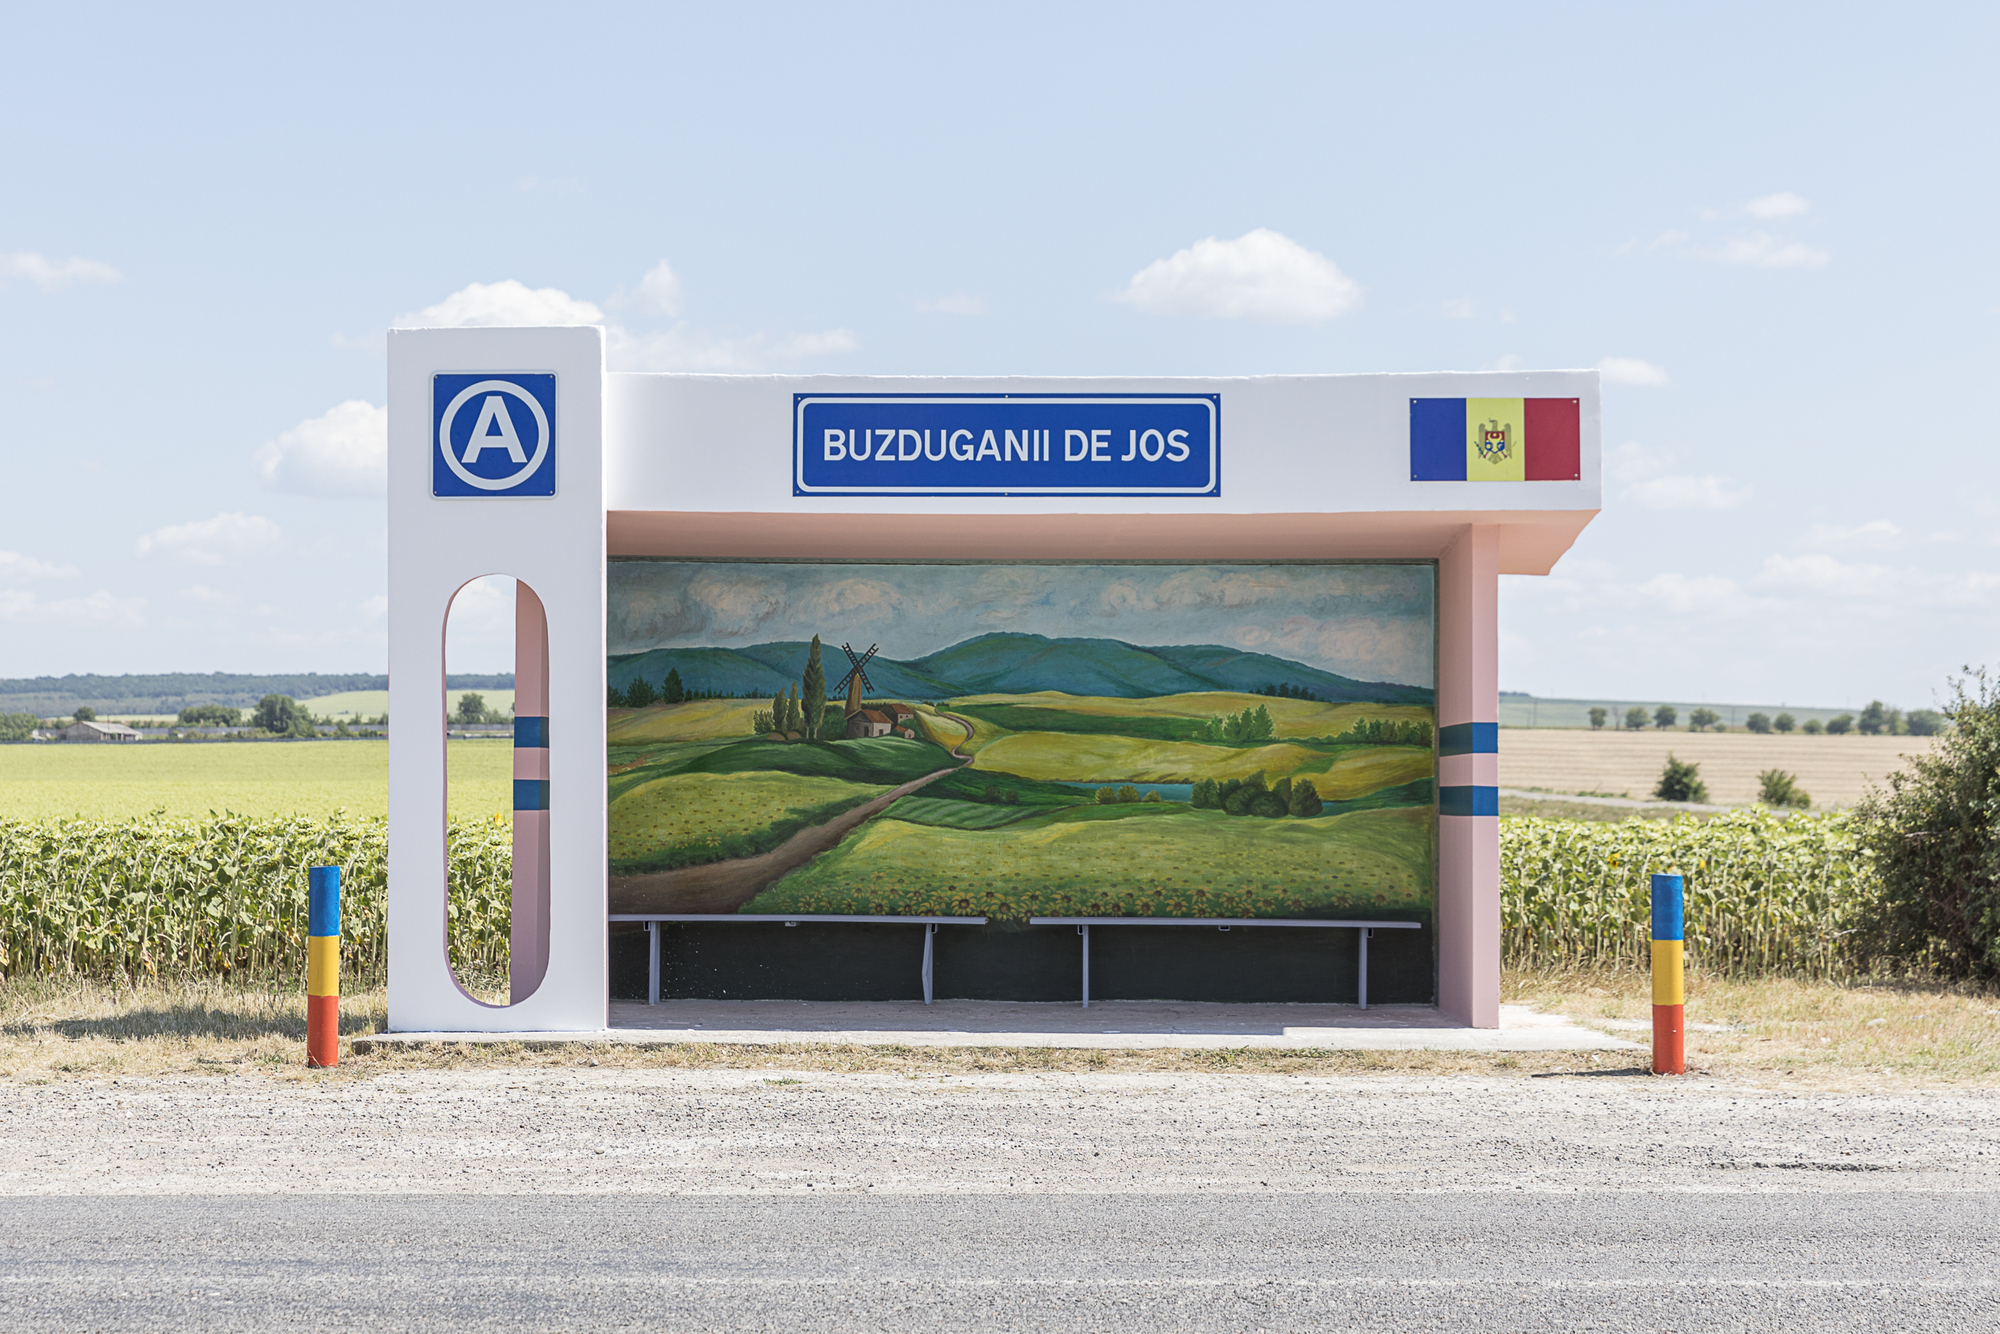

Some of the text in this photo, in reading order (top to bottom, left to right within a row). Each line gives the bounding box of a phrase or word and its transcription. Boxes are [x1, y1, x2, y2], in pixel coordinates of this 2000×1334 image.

[461, 395, 528, 464] A
[823, 428, 1190, 462] BUZDUGANII DE JOS
